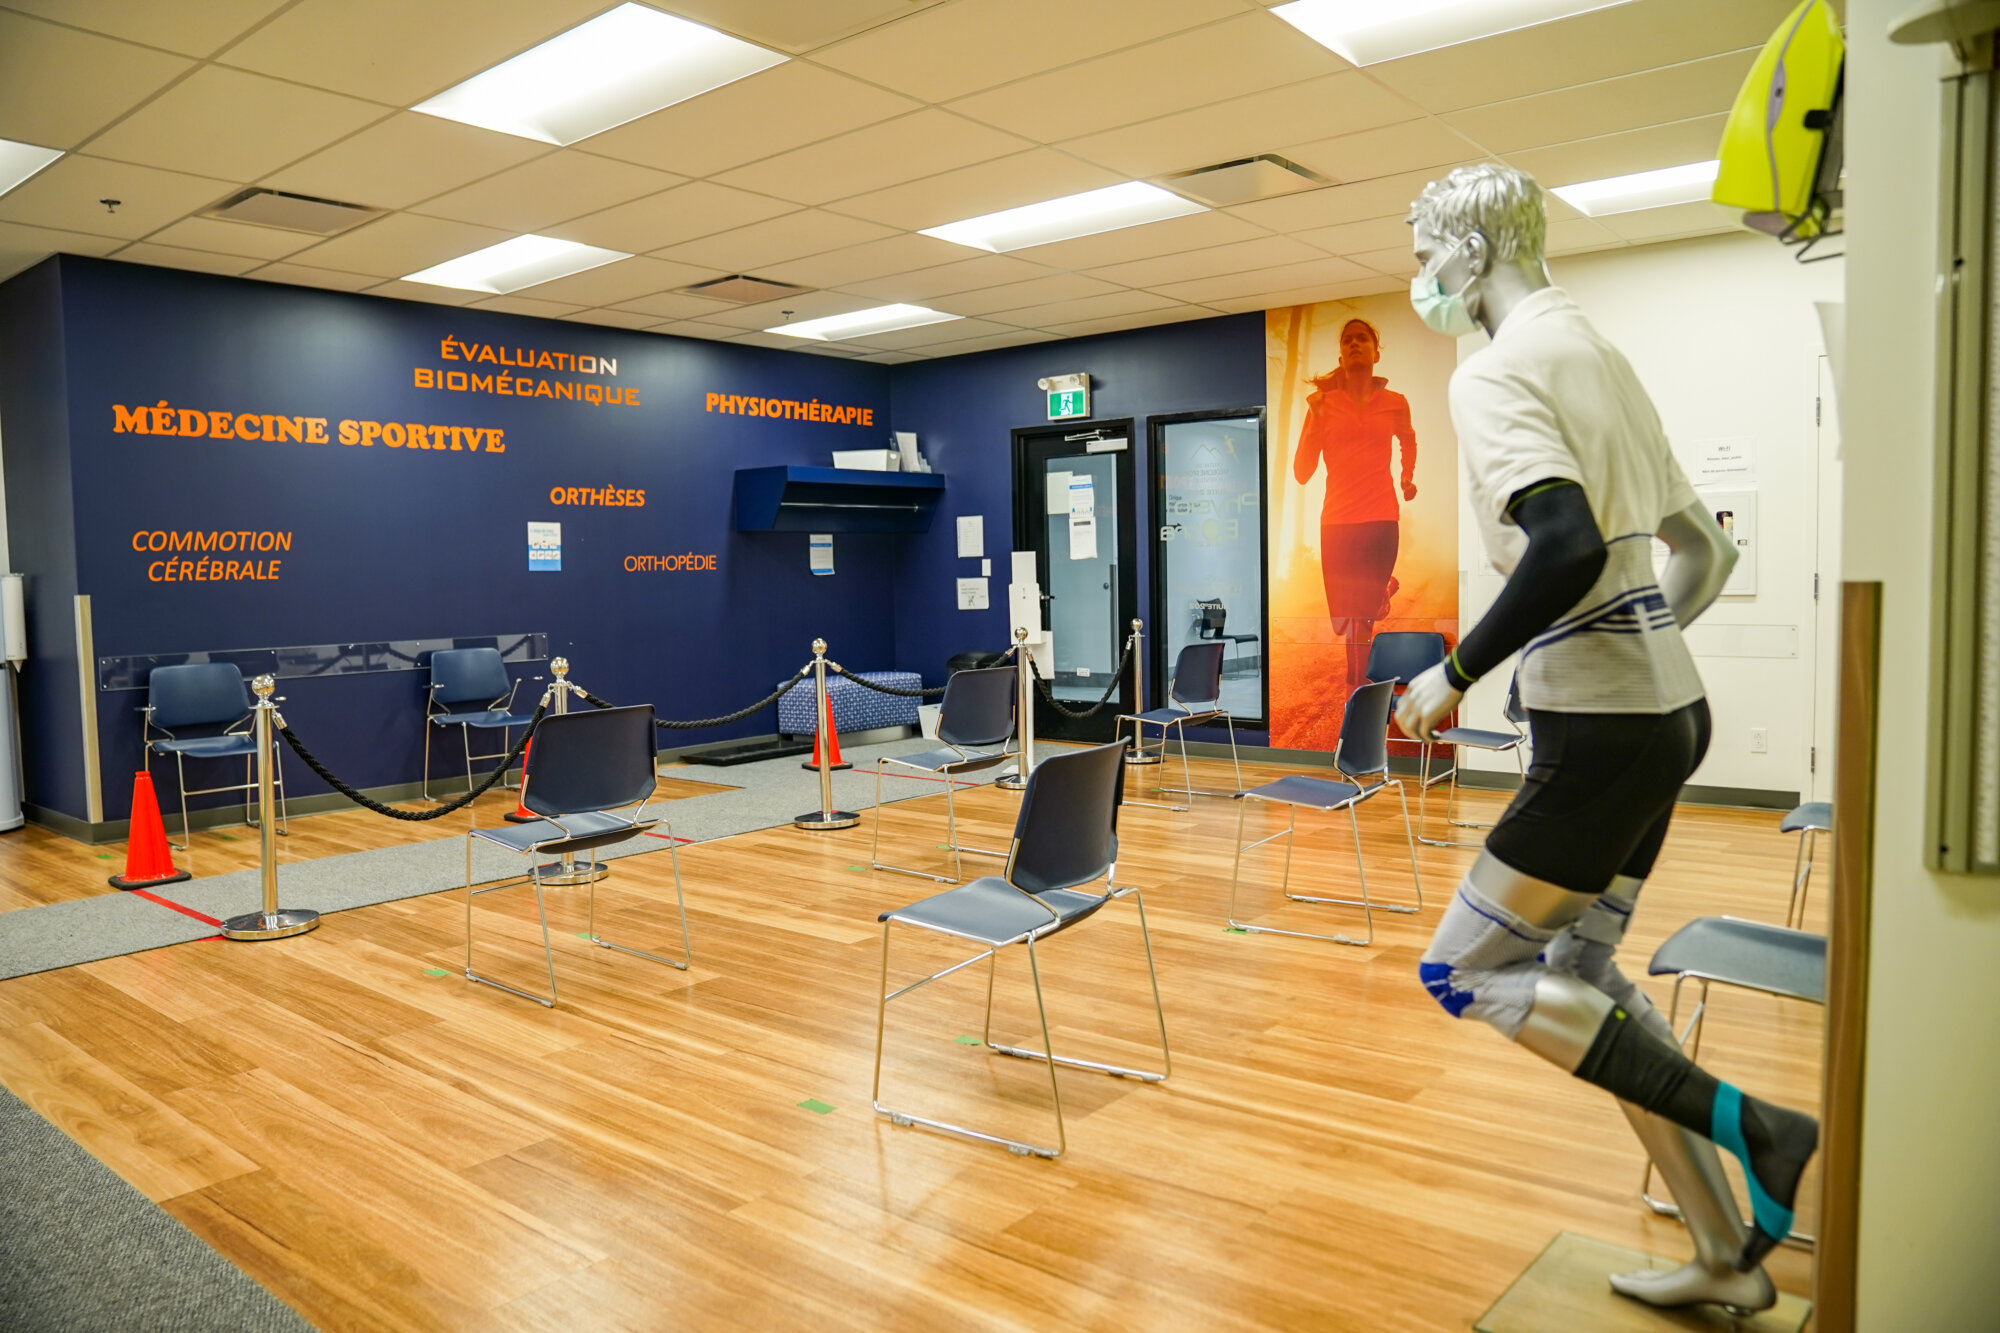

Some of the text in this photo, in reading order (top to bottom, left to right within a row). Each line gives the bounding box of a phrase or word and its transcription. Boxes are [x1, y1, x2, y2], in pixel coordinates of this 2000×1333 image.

[440, 334, 618, 377] ÉVALUATION
[414, 368, 641, 407] BIOMÉCANIQUE
[705, 392, 874, 427] PHYSIOTHÉRAPIE
[112, 400, 506, 454] MÉDECINE SPORTIVE
[549, 484, 646, 508] ORTHÈSES
[131, 530, 293, 552] COMMOTION
[147, 555, 281, 582] CÉRÉBRALE
[623, 551, 717, 572] ORTHOPÉDIE
